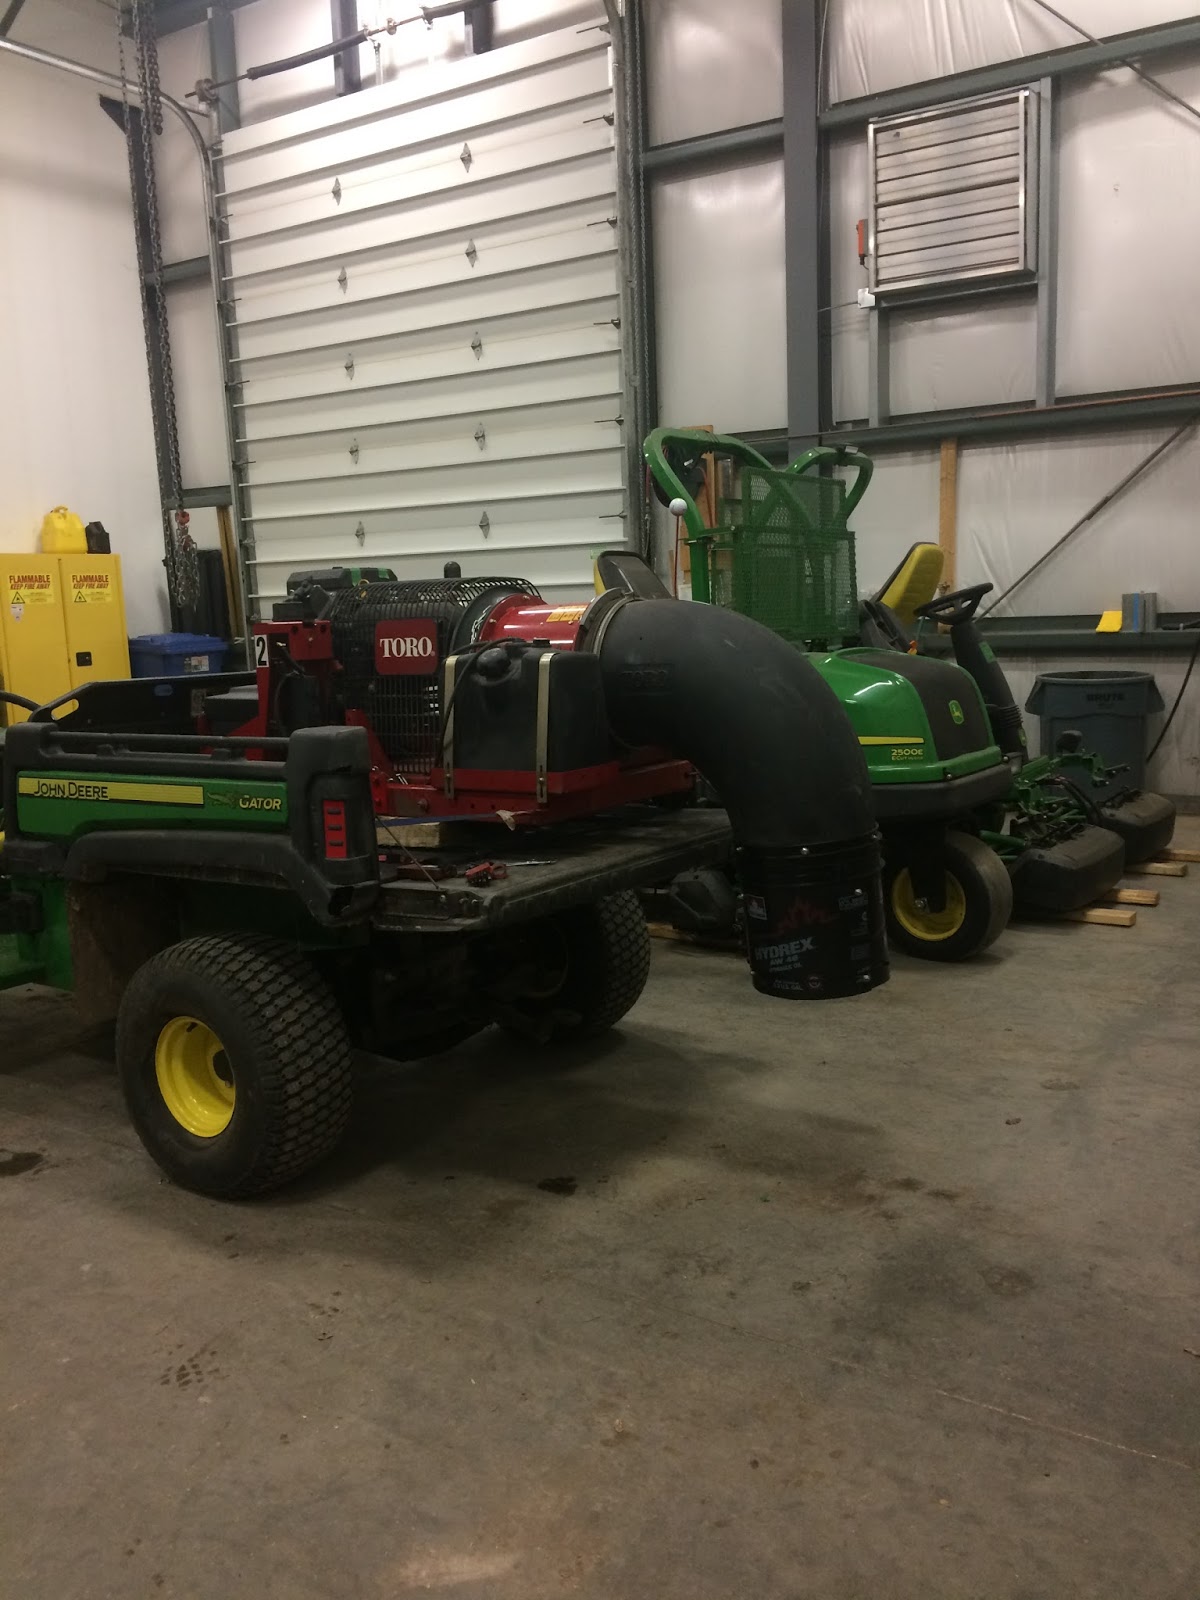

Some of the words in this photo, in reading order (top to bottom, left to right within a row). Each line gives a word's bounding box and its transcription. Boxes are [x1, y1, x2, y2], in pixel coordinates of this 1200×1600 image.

[9, 574, 51, 584] FLAMMABLE
[71, 574, 109, 583] FLAMMABLE
[256, 636, 267, 666] 2
[379, 636, 433, 658] TORO
[34, 781, 66, 798] JOHN
[68, 782, 109, 800] DEERE
[239, 797, 282, 811] GATOR
[754, 936, 813, 960] HYDREX
